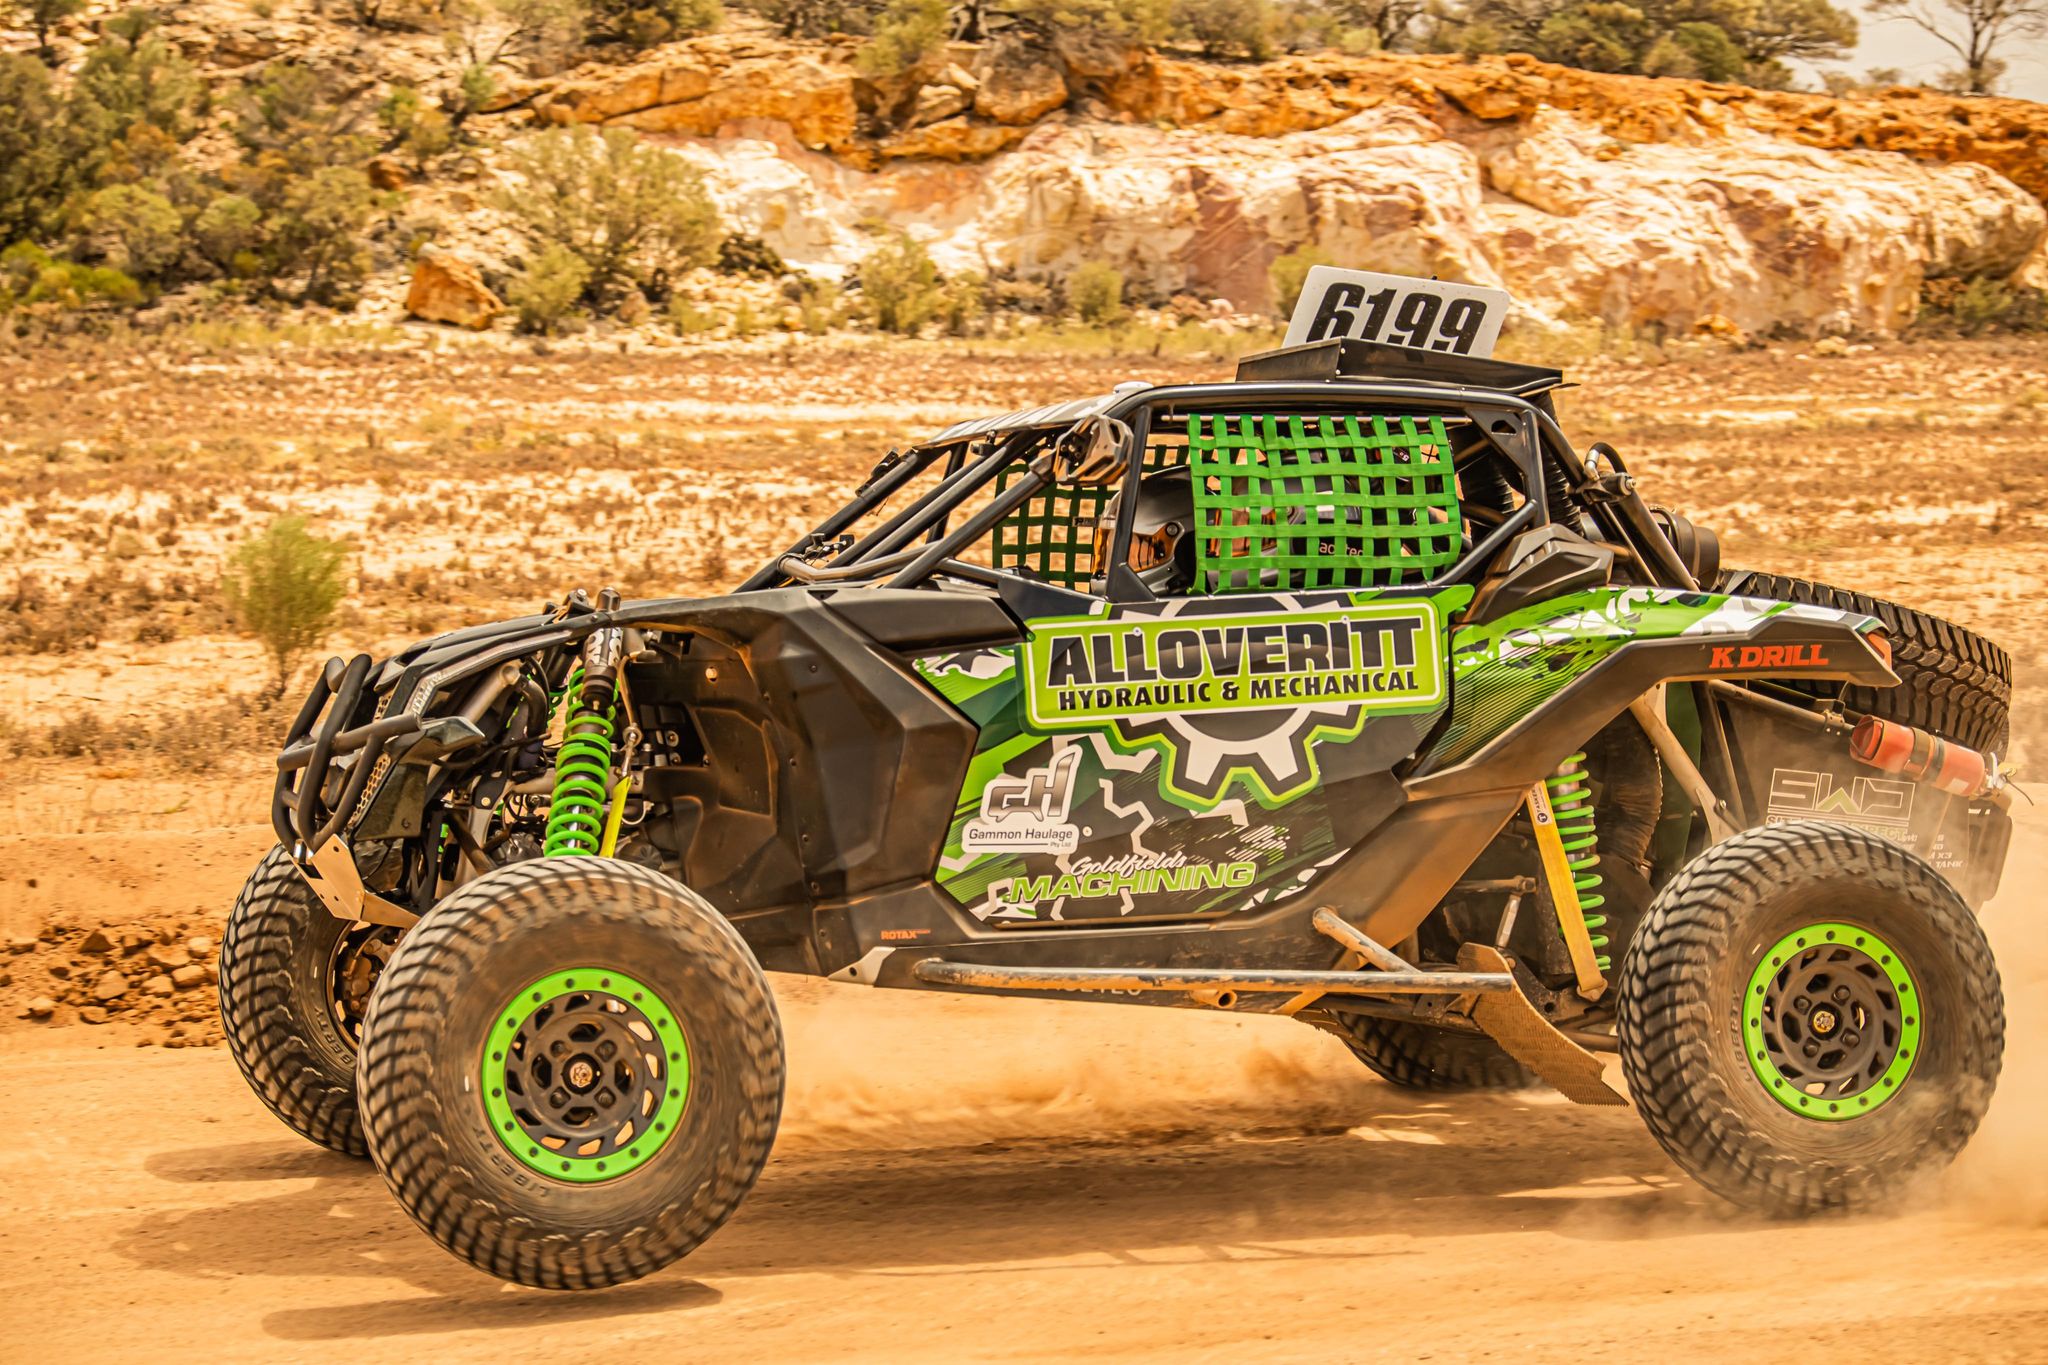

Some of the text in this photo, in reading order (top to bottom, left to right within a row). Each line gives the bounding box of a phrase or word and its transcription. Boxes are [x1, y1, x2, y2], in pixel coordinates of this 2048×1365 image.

[1306, 282, 1487, 355] 6199
[1048, 617, 1423, 687] ALLOVERITT
[1709, 644, 1829, 668] K DRILL
[1059, 671, 1418, 711] HYDRAULIC & MECHANICAL
[969, 828, 1073, 841] Gammon Haulage
[1070, 851, 1187, 878] Goldfields
[1010, 861, 1257, 903] MACHINING
[881, 930, 917, 940] ROTAX
